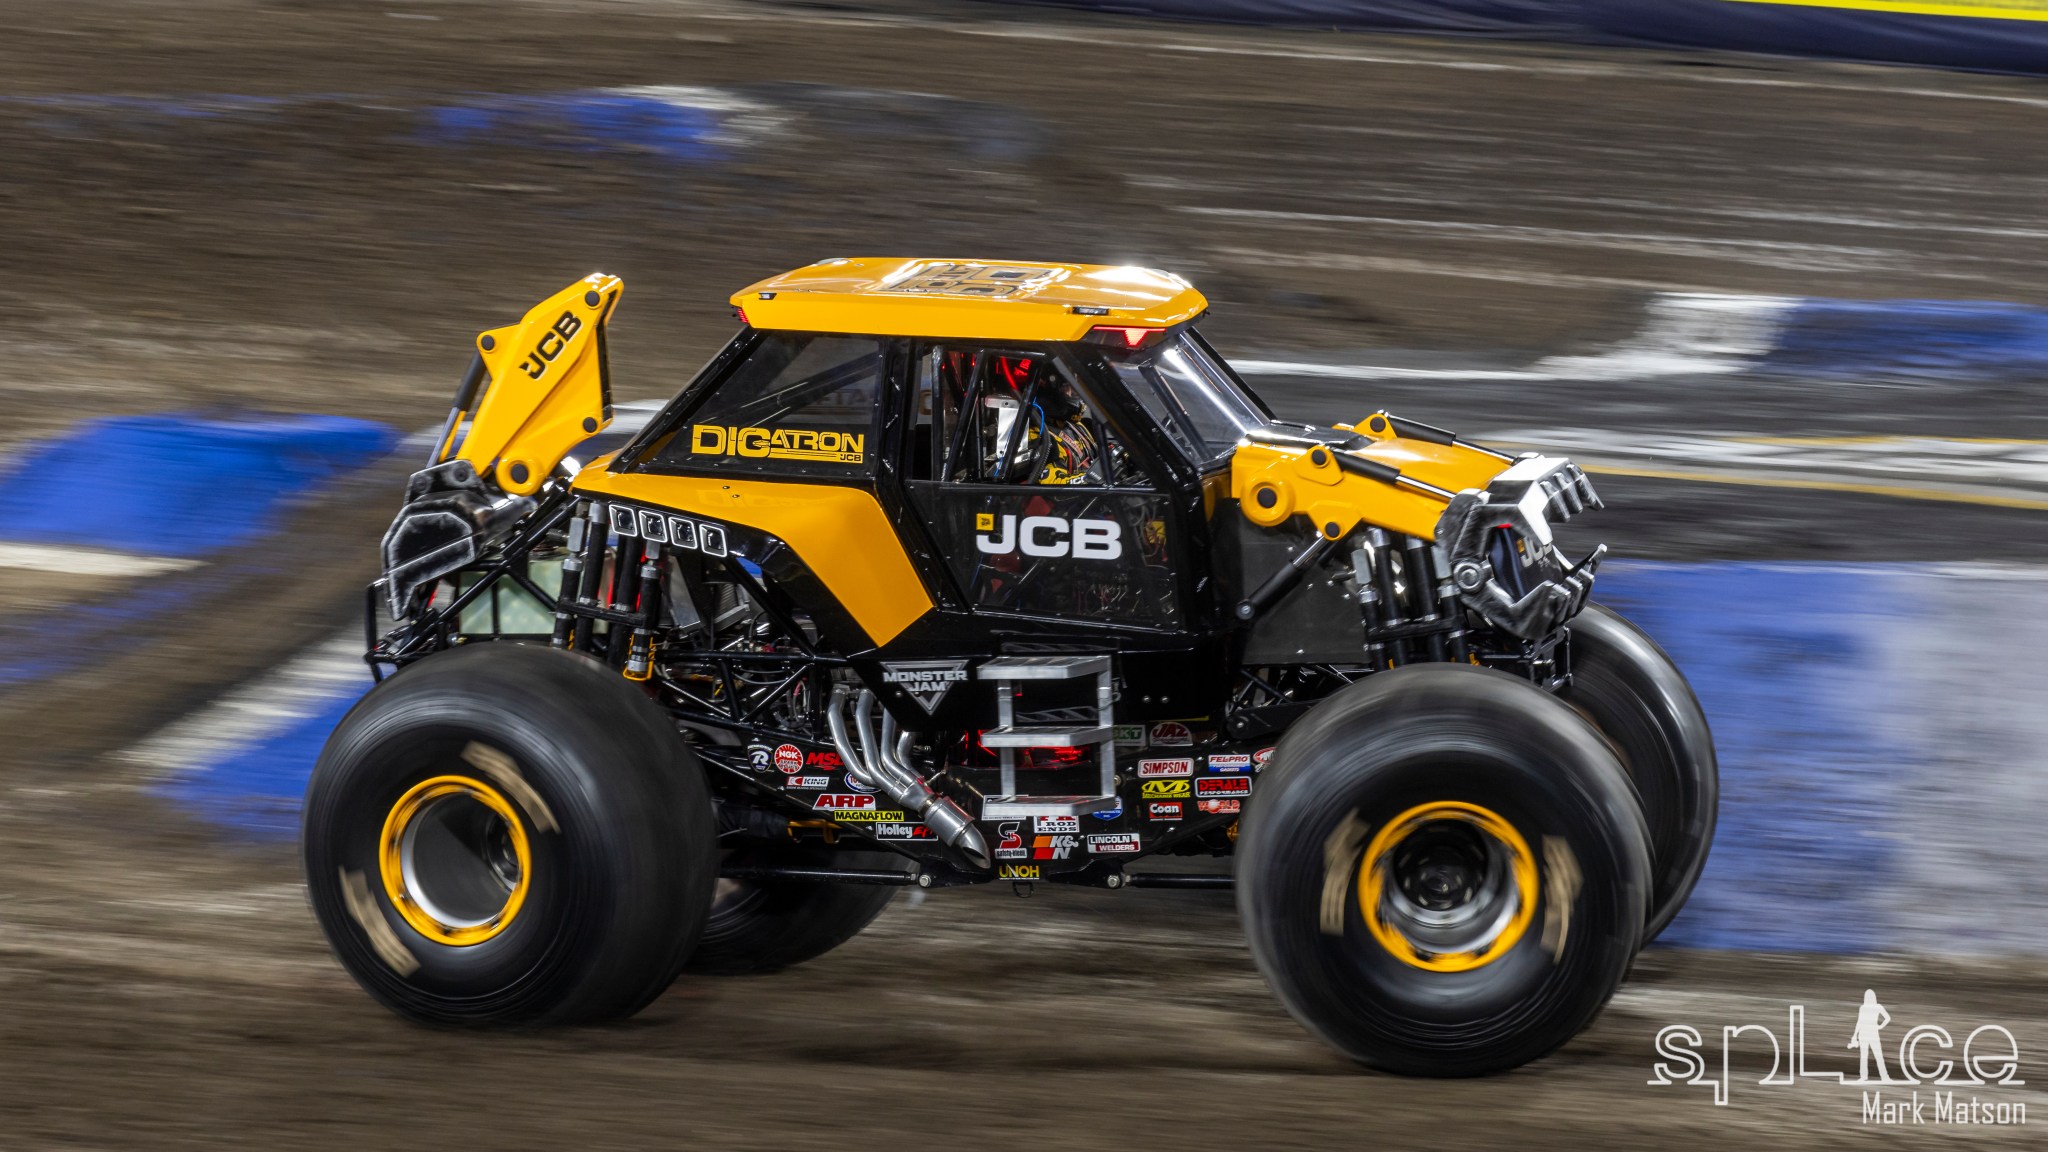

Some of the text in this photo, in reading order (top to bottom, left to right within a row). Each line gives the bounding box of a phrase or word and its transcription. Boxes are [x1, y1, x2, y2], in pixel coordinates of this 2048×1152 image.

[519, 310, 583, 380] JCB
[691, 424, 864, 458] DIGATRON
[840, 453, 862, 462] JCB
[976, 513, 1122, 560] JCB
[883, 670, 968, 683] MONSTER
[907, 682, 947, 692] JAM
[1152, 723, 1189, 738] JAZ
[779, 750, 798, 760] NGK
[1143, 762, 1188, 774] SIMPSON
[804, 778, 827, 786] KING
[1198, 779, 1248, 791] DERALE
[816, 794, 875, 808] ARP
[1149, 803, 1179, 814] Coan
[835, 811, 903, 820] MAGNAFLOW
[877, 824, 913, 838] Holley
[1090, 835, 1130, 844] LINCOLN
[999, 863, 1040, 878] UNOH
